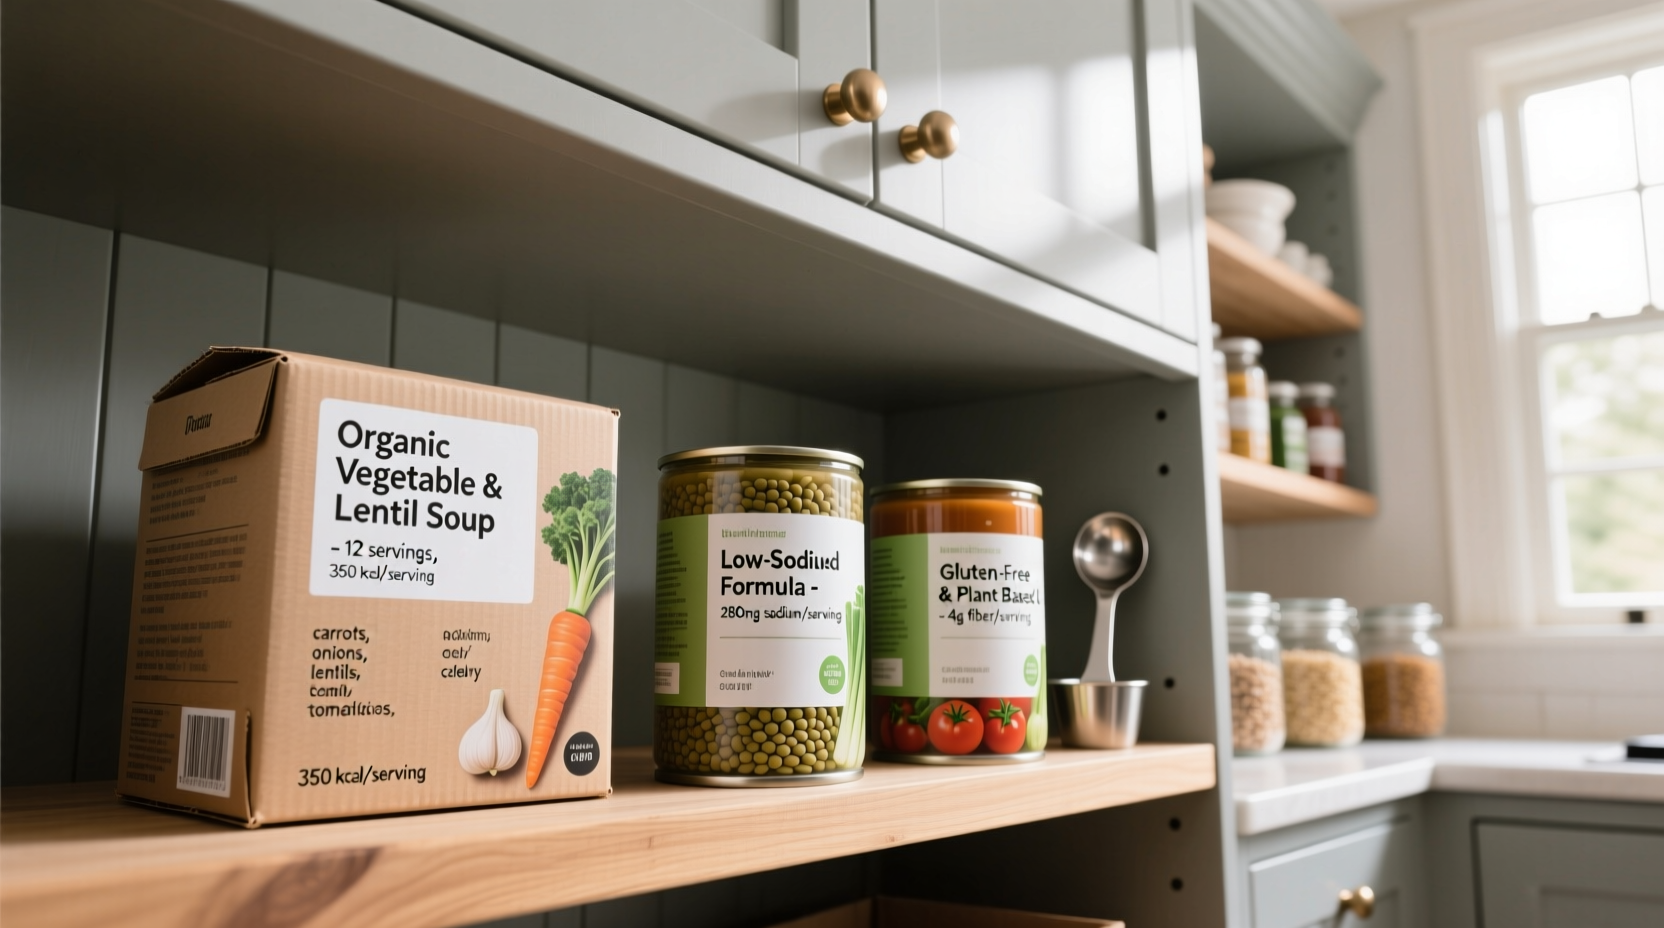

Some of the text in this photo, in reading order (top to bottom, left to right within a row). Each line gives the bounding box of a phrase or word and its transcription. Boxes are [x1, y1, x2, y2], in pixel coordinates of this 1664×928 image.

[337, 419, 451, 460] Organic
[335, 456, 503, 500] Vegetable &
[334, 493, 495, 540] Lentil Soup
[345, 539, 363, 557] 12
[368, 542, 438, 565] servings,
[329, 563, 357, 579] 350
[940, 562, 1031, 583] Gluten-Free
[720, 576, 806, 597] Formula
[938, 585, 953, 603] &
[957, 585, 999, 603] Plant
[947, 608, 965, 626] 4g
[312, 626, 370, 644] carrots,
[311, 646, 368, 664] onions,
[310, 664, 361, 682] lentils,
[297, 764, 427, 787] 350 kcal/serving
